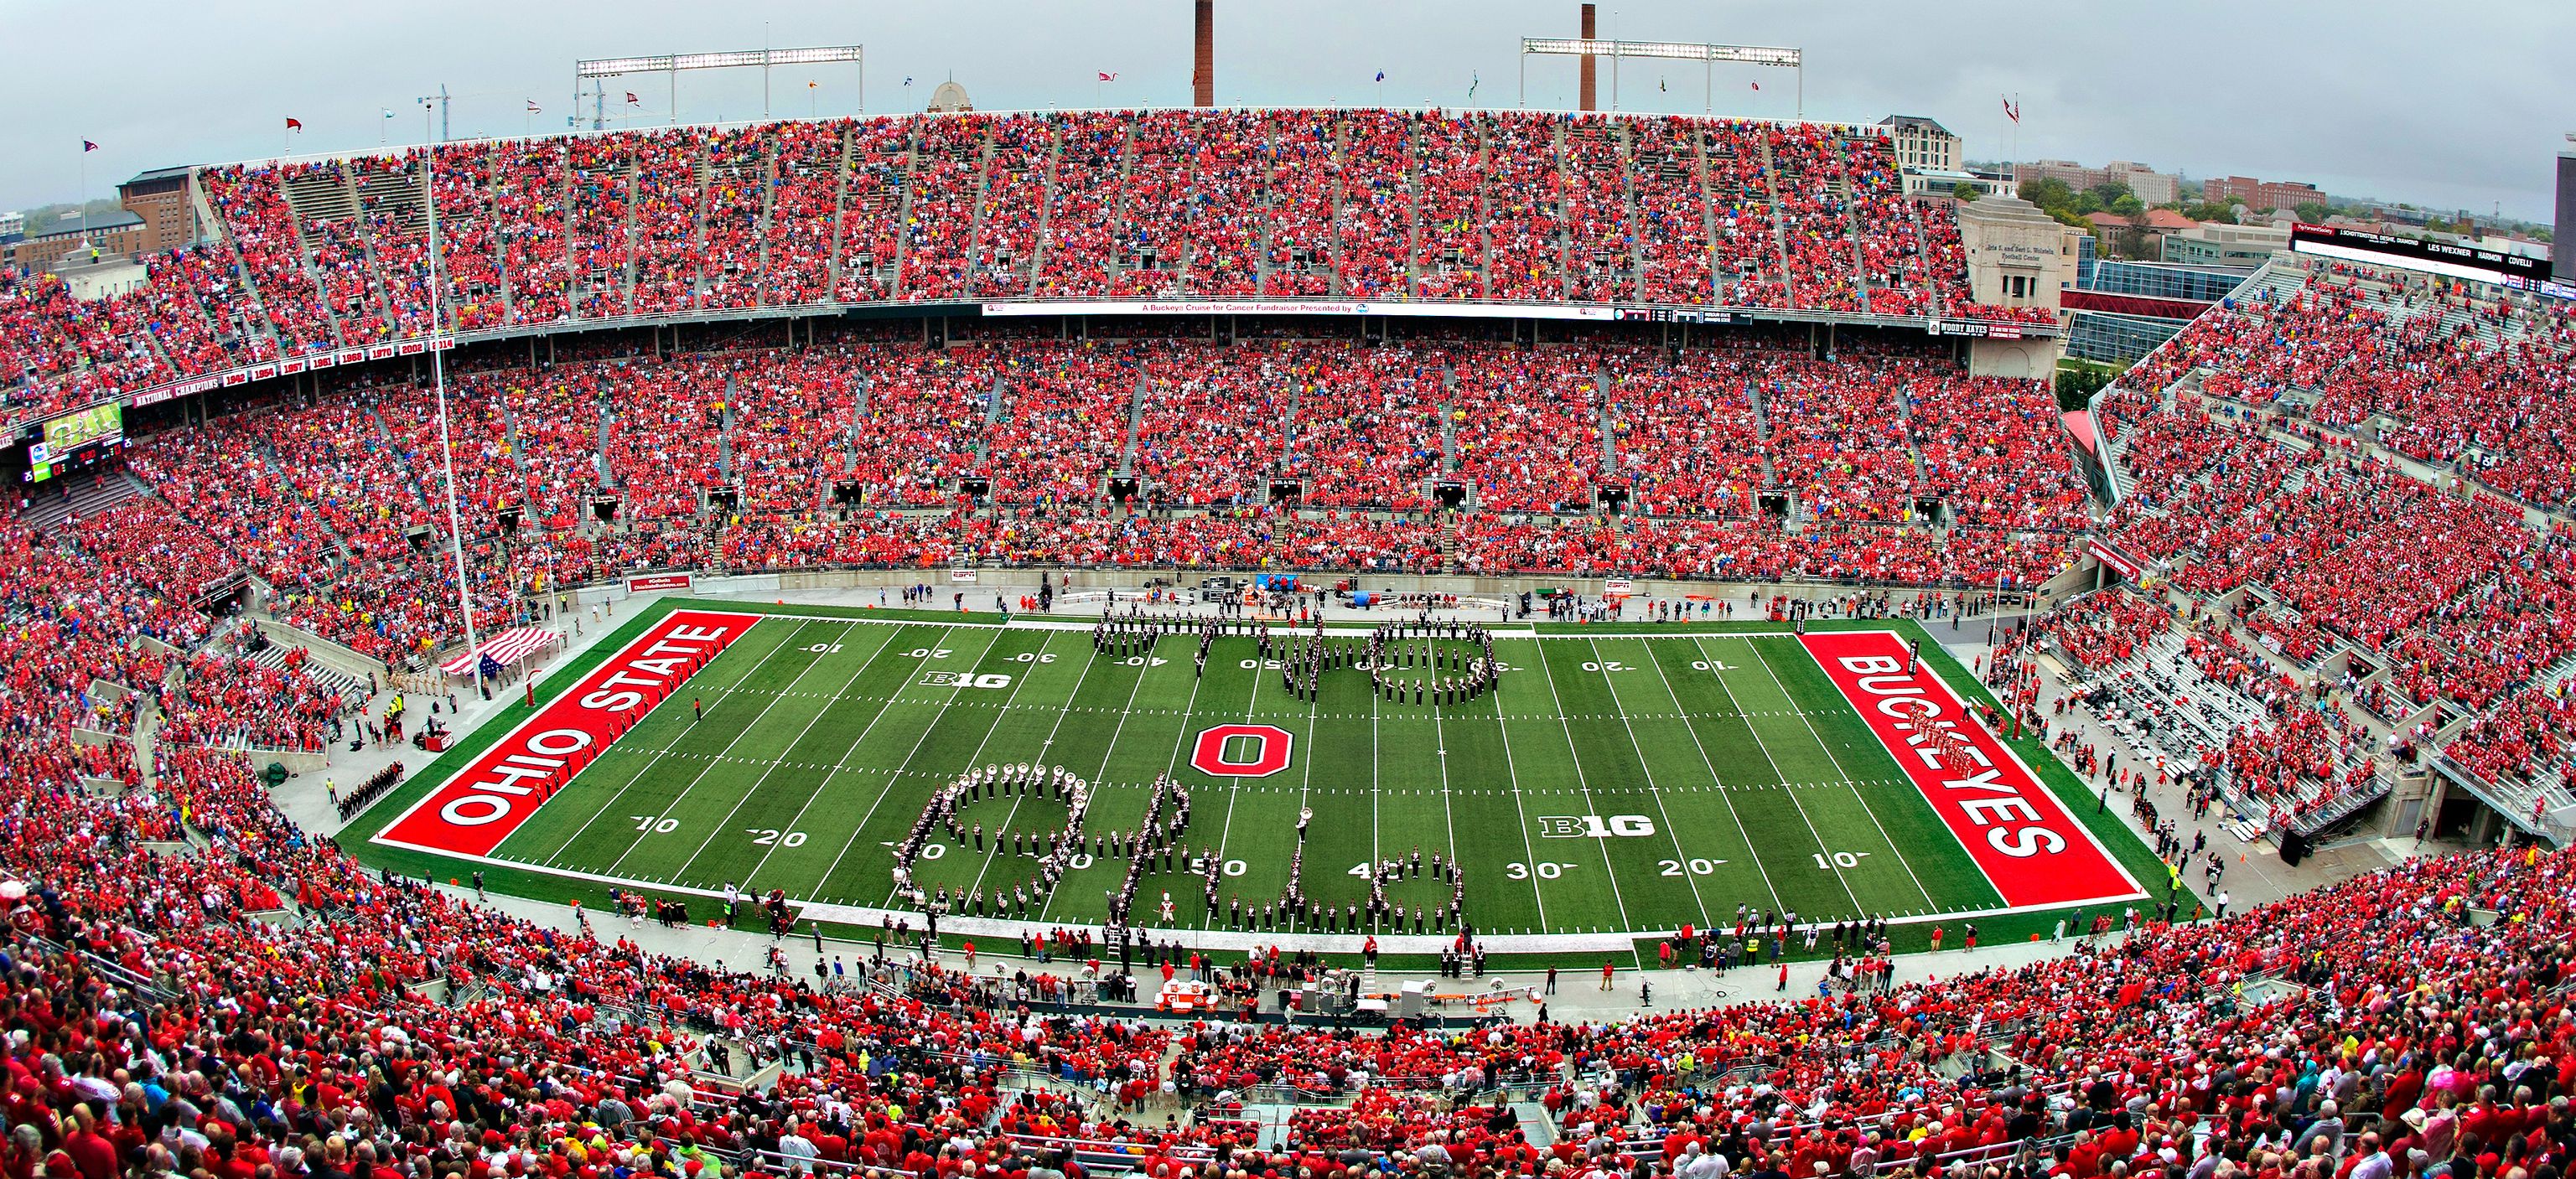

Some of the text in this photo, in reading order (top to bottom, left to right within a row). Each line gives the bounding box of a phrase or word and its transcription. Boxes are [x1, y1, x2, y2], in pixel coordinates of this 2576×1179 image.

[2428, 243, 2440, 252] LES
[2441, 246, 2471, 257] WEXNER
[2477, 251, 2502, 262] HARMON
[2508, 256, 2532, 268] COVELLI
[1301, 304, 1340, 313] Presented
[1342, 304, 1352, 313] by
[1941, 323, 1988, 334] WOODY HAYES
[371, 347, 392, 359] 1970
[402, 344, 422, 354] 2002
[313, 356, 333, 368] 1961
[342, 352, 362, 364] 1968
[254, 367, 274, 380] 1954
[283, 362, 303, 374] 1957
[225, 373, 246, 385] 1942
[136, 379, 219, 407] NATIONAL CHAMPIONS
[438, 623, 739, 826] OHIO STATE
[635, 815, 680, 834] 10
[753, 829, 808, 848] 20
[1657, 857, 1715, 876] 20
[1811, 851, 1859, 870] 10
[1506, 861, 1565, 880] 30
